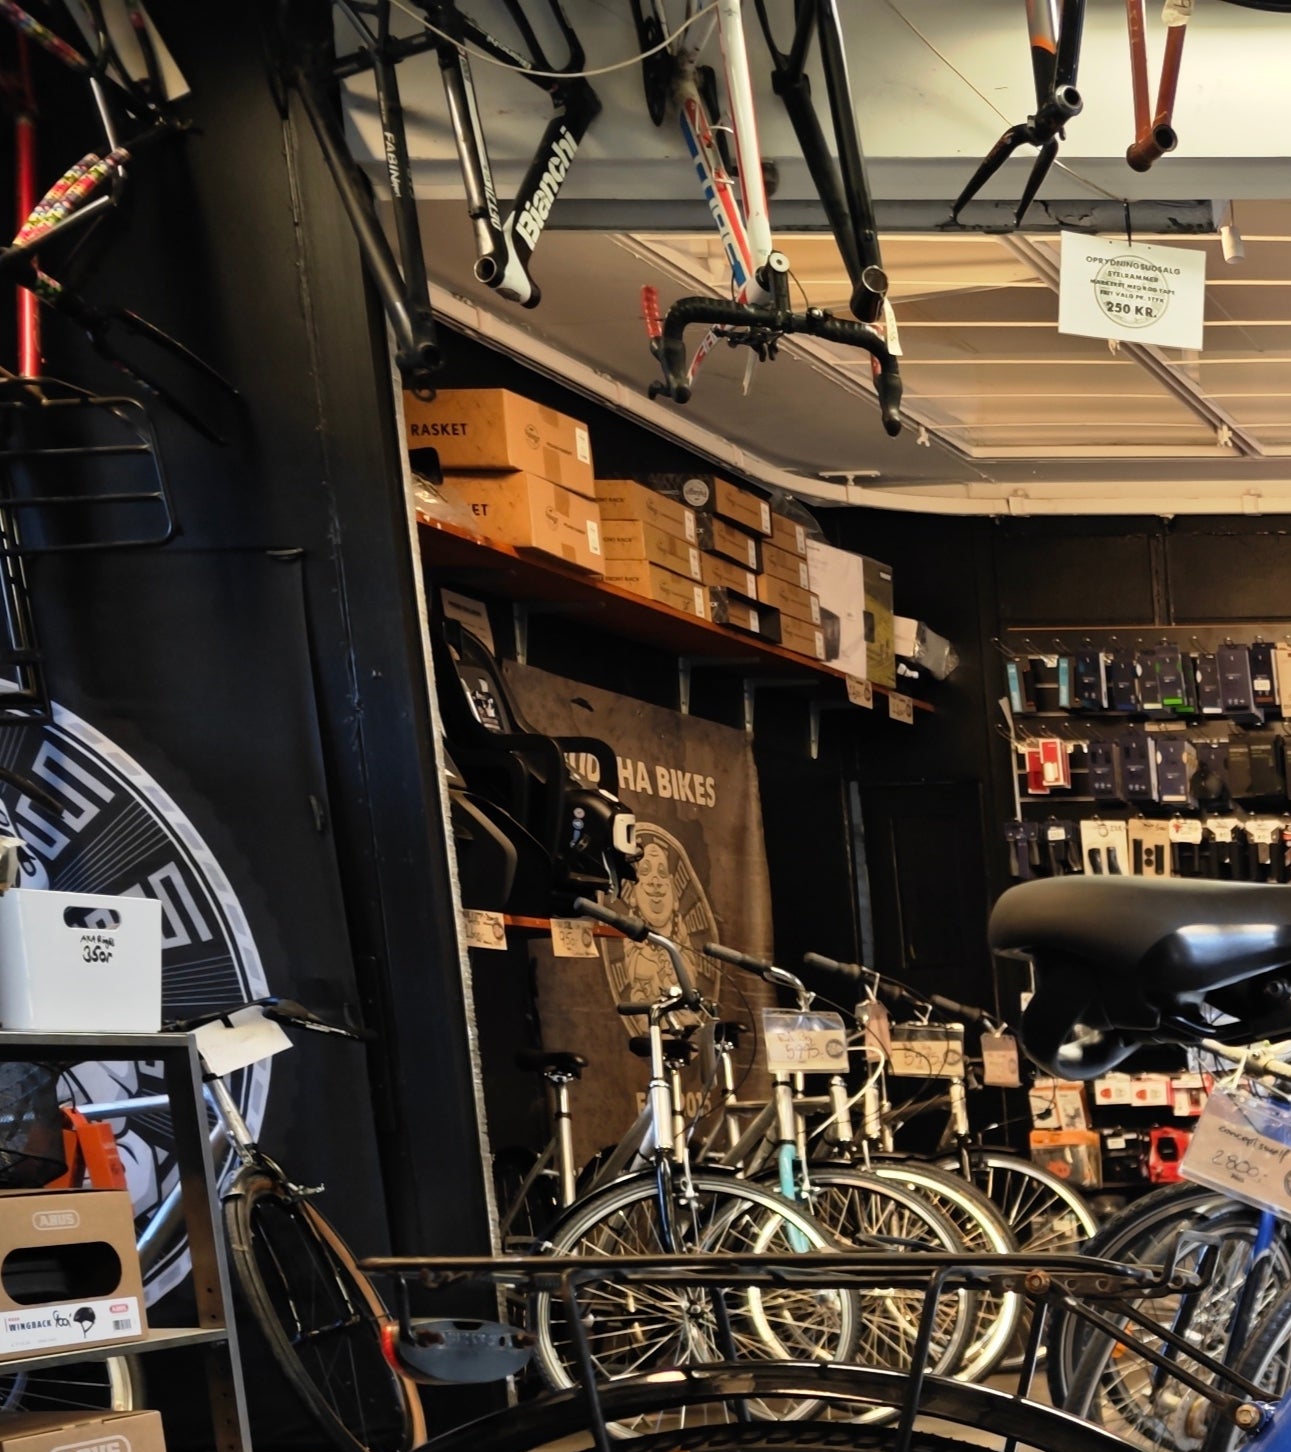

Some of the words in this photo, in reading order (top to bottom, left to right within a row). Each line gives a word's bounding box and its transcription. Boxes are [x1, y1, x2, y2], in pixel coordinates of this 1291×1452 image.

[515, 126, 578, 252] Bianchi
[1106, 300, 1131, 314] 250
[1135, 305, 1157, 318] KR.
[654, 764, 716, 808] BIKES
[9, 1320, 52, 1332] WINGBACK
